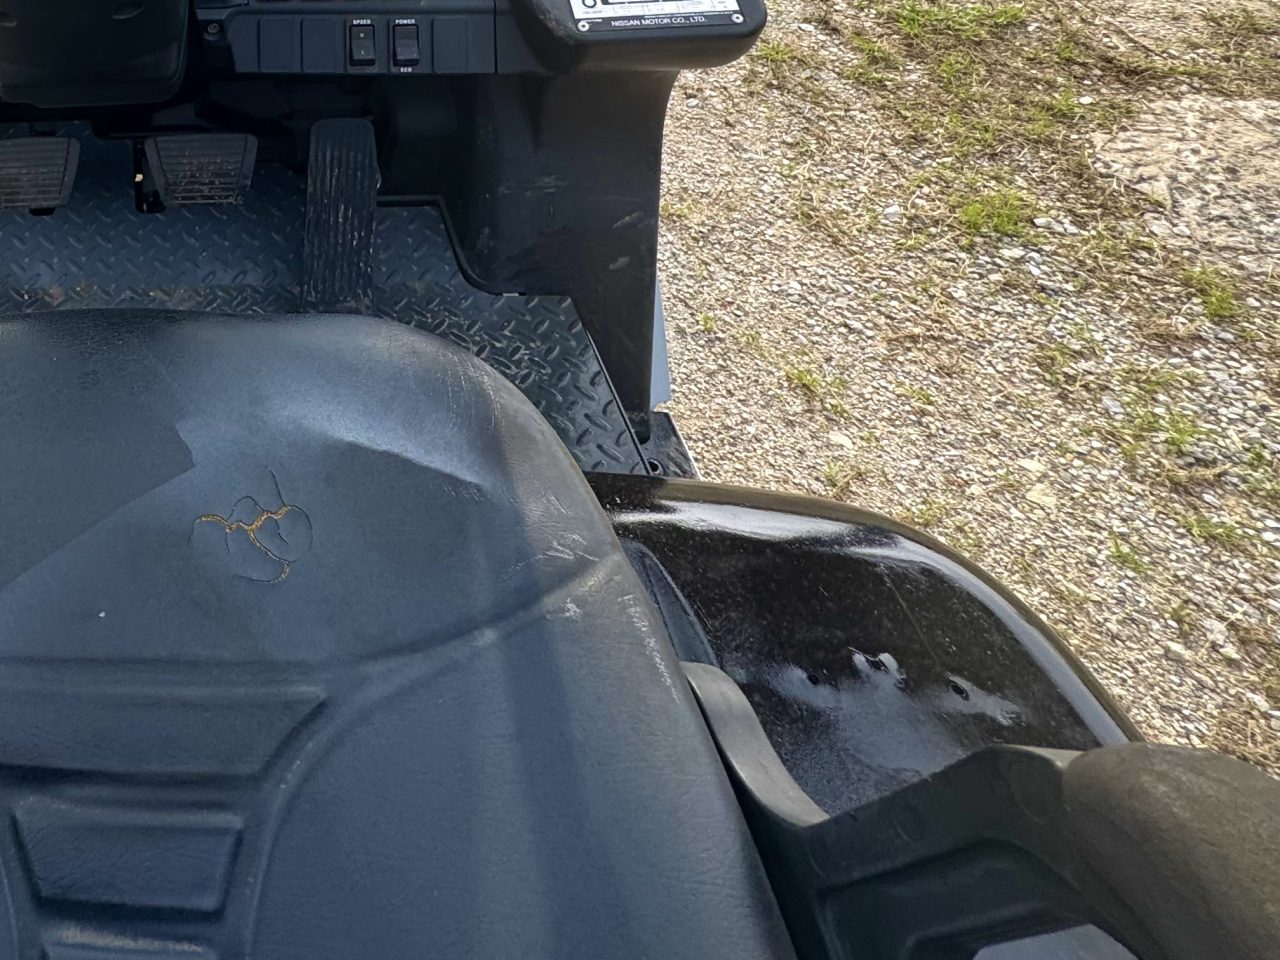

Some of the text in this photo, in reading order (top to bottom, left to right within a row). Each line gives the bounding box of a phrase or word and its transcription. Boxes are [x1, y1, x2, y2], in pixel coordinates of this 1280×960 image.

[611, 19, 641, 27] NISSAN
[641, 17, 671, 26] MOTOR
[690, 16, 707, 24] LTD.
